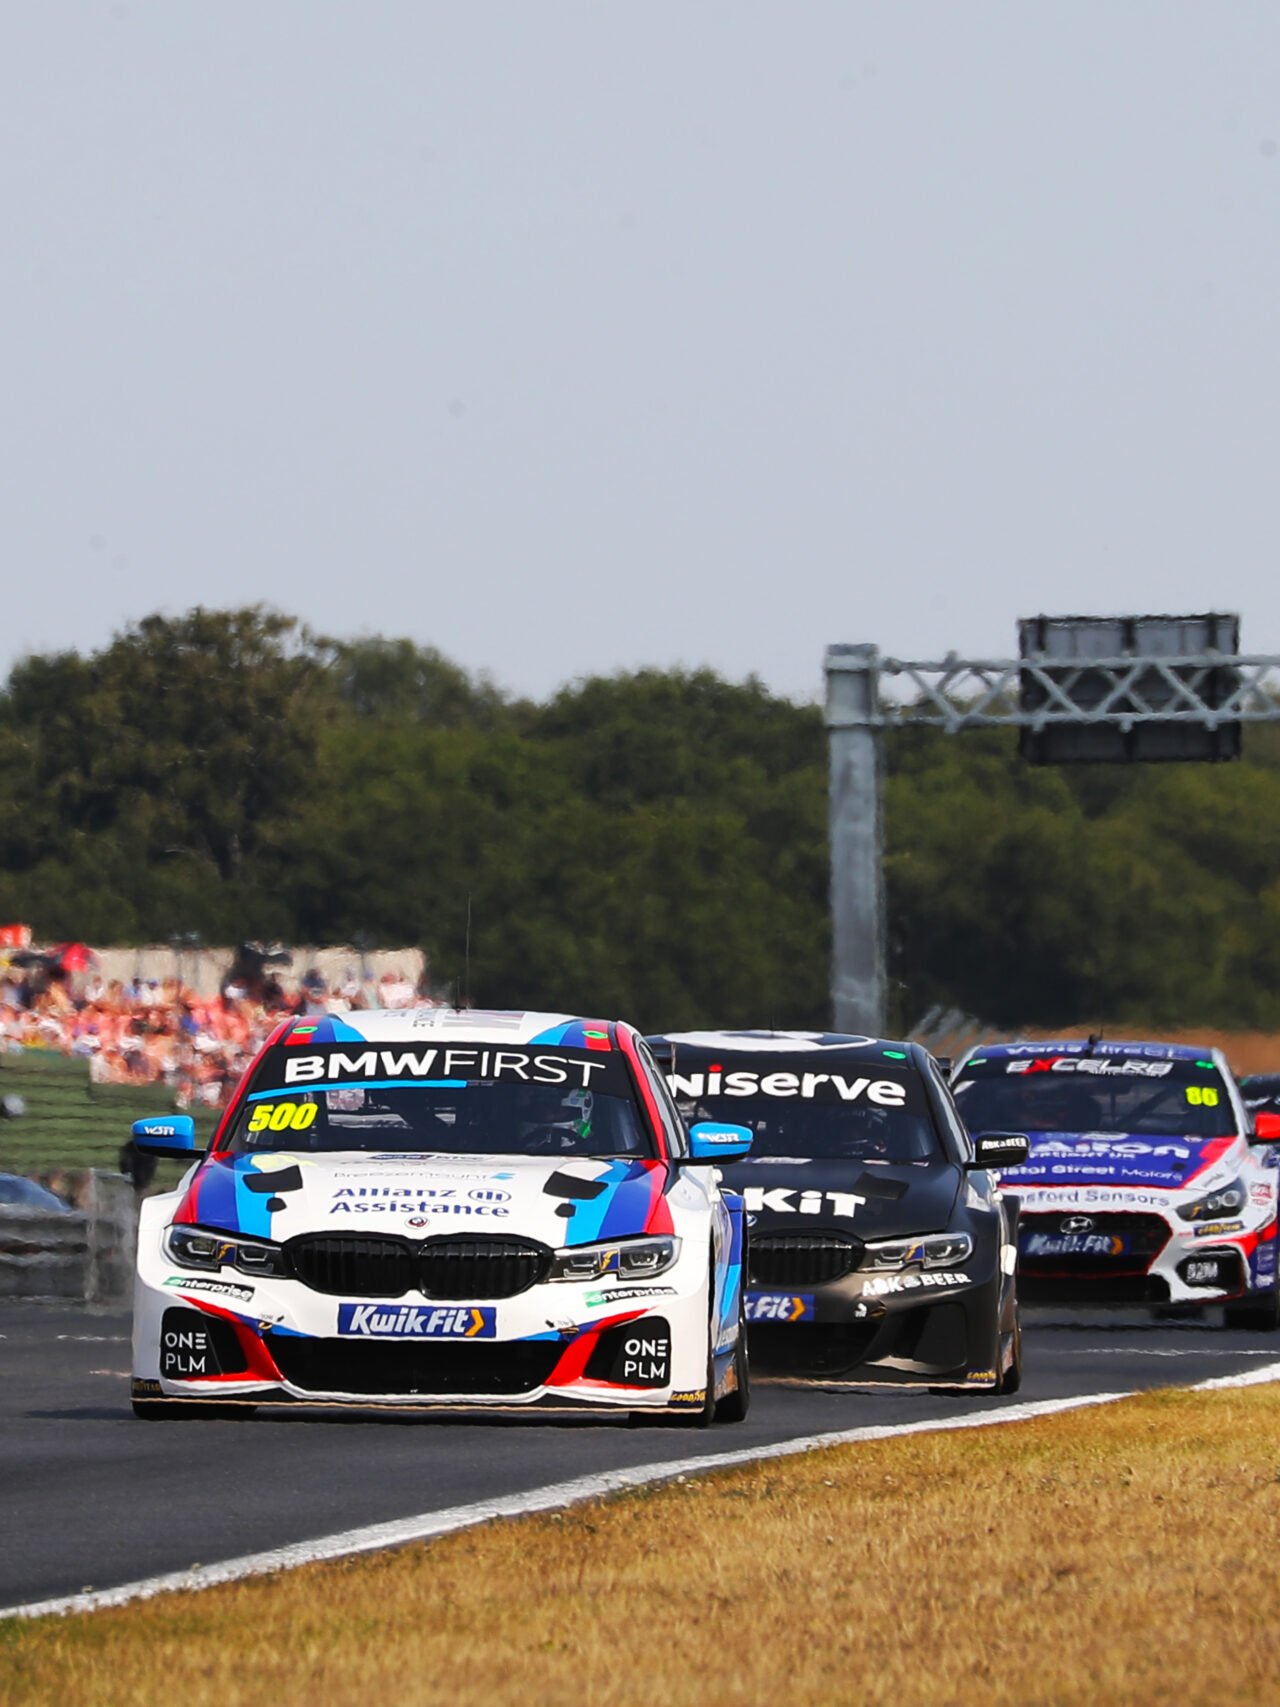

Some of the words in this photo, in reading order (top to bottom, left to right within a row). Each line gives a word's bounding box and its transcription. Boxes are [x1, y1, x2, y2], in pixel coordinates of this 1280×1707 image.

[248, 1103, 318, 1132] 500
[1052, 1164, 1115, 1175] Street
[332, 1187, 457, 1198] Allianz
[1086, 1189, 1171, 1208] Sensors
[328, 1201, 510, 1217] Assistance
[167, 1278, 254, 1299] enterprise
[585, 1287, 676, 1303] enterprise
[165, 1332, 207, 1350] ONE
[624, 1338, 669, 1357] ONE
[165, 1353, 206, 1373] PLM
[624, 1360, 666, 1379] PLM
